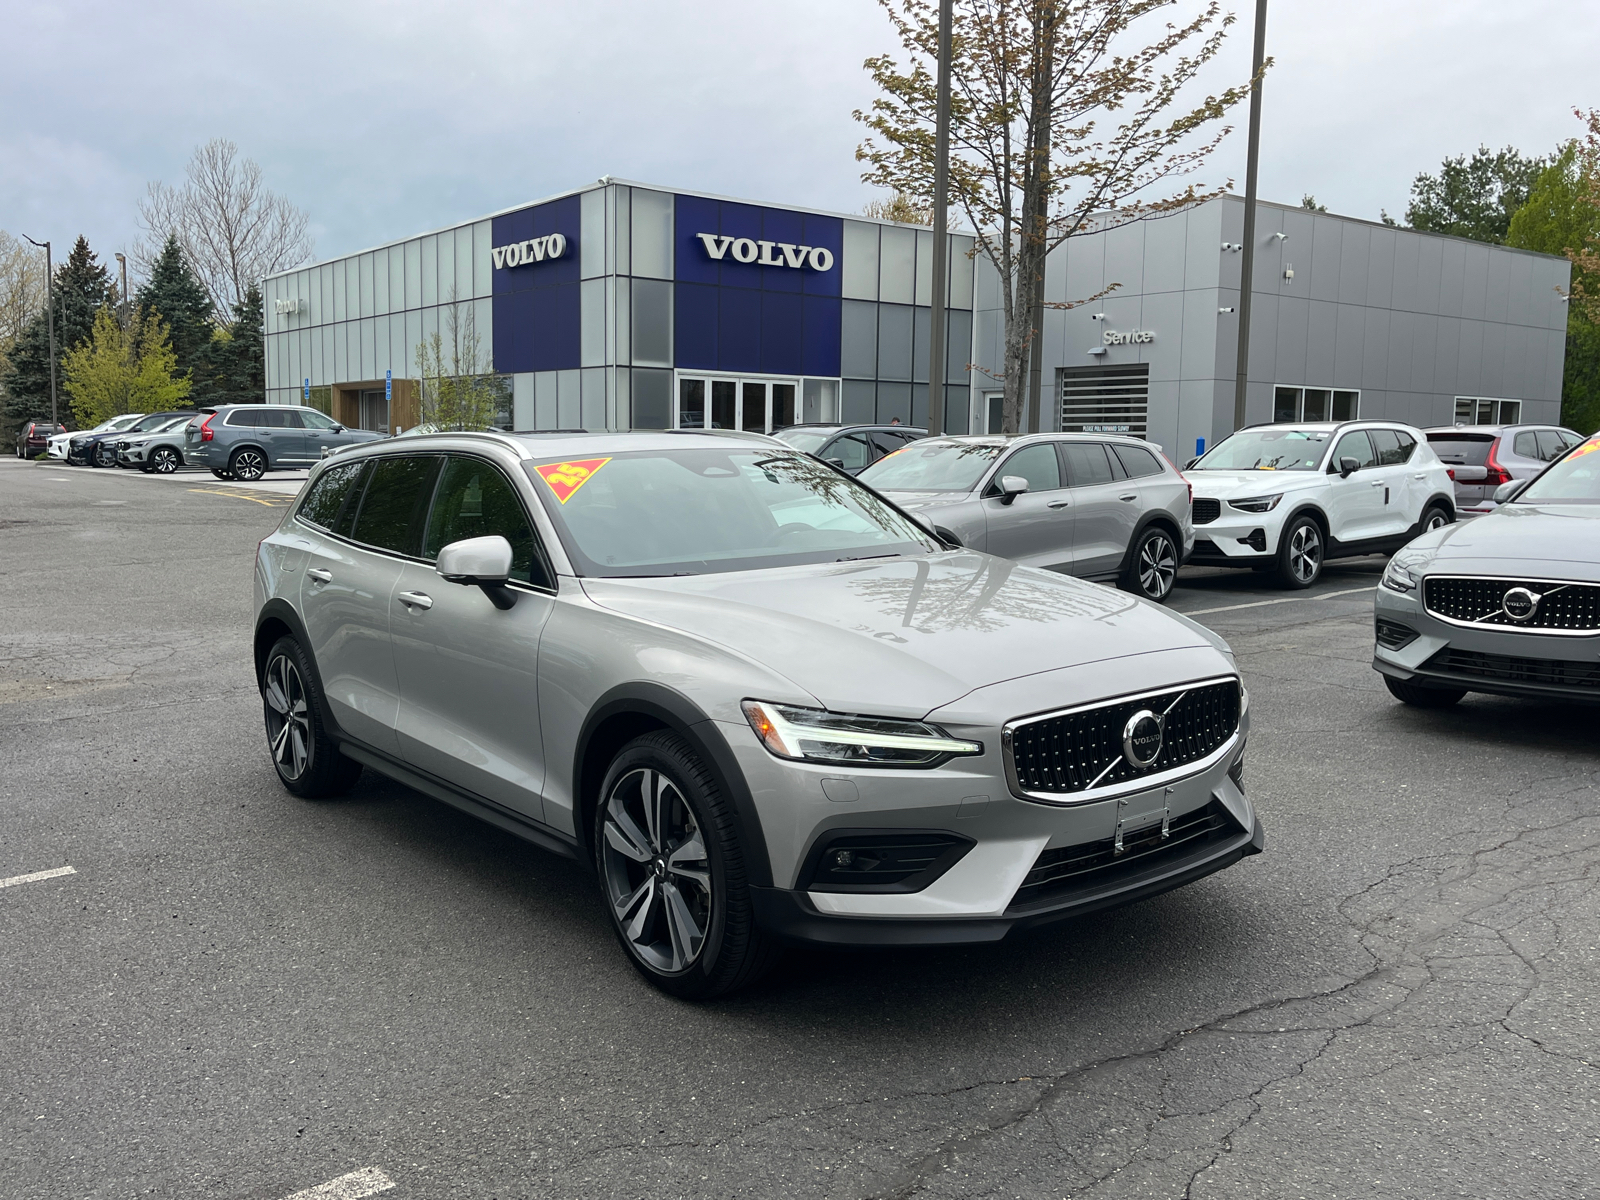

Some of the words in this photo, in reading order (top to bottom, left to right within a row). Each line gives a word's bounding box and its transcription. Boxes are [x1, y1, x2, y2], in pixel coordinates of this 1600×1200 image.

[491, 233, 565, 270] VOLVO
[696, 233, 834, 272] VOLVO
[1103, 329, 1153, 345] Service
[547, 463, 589, 487] 25
[1133, 734, 1160, 745] VOLVO
